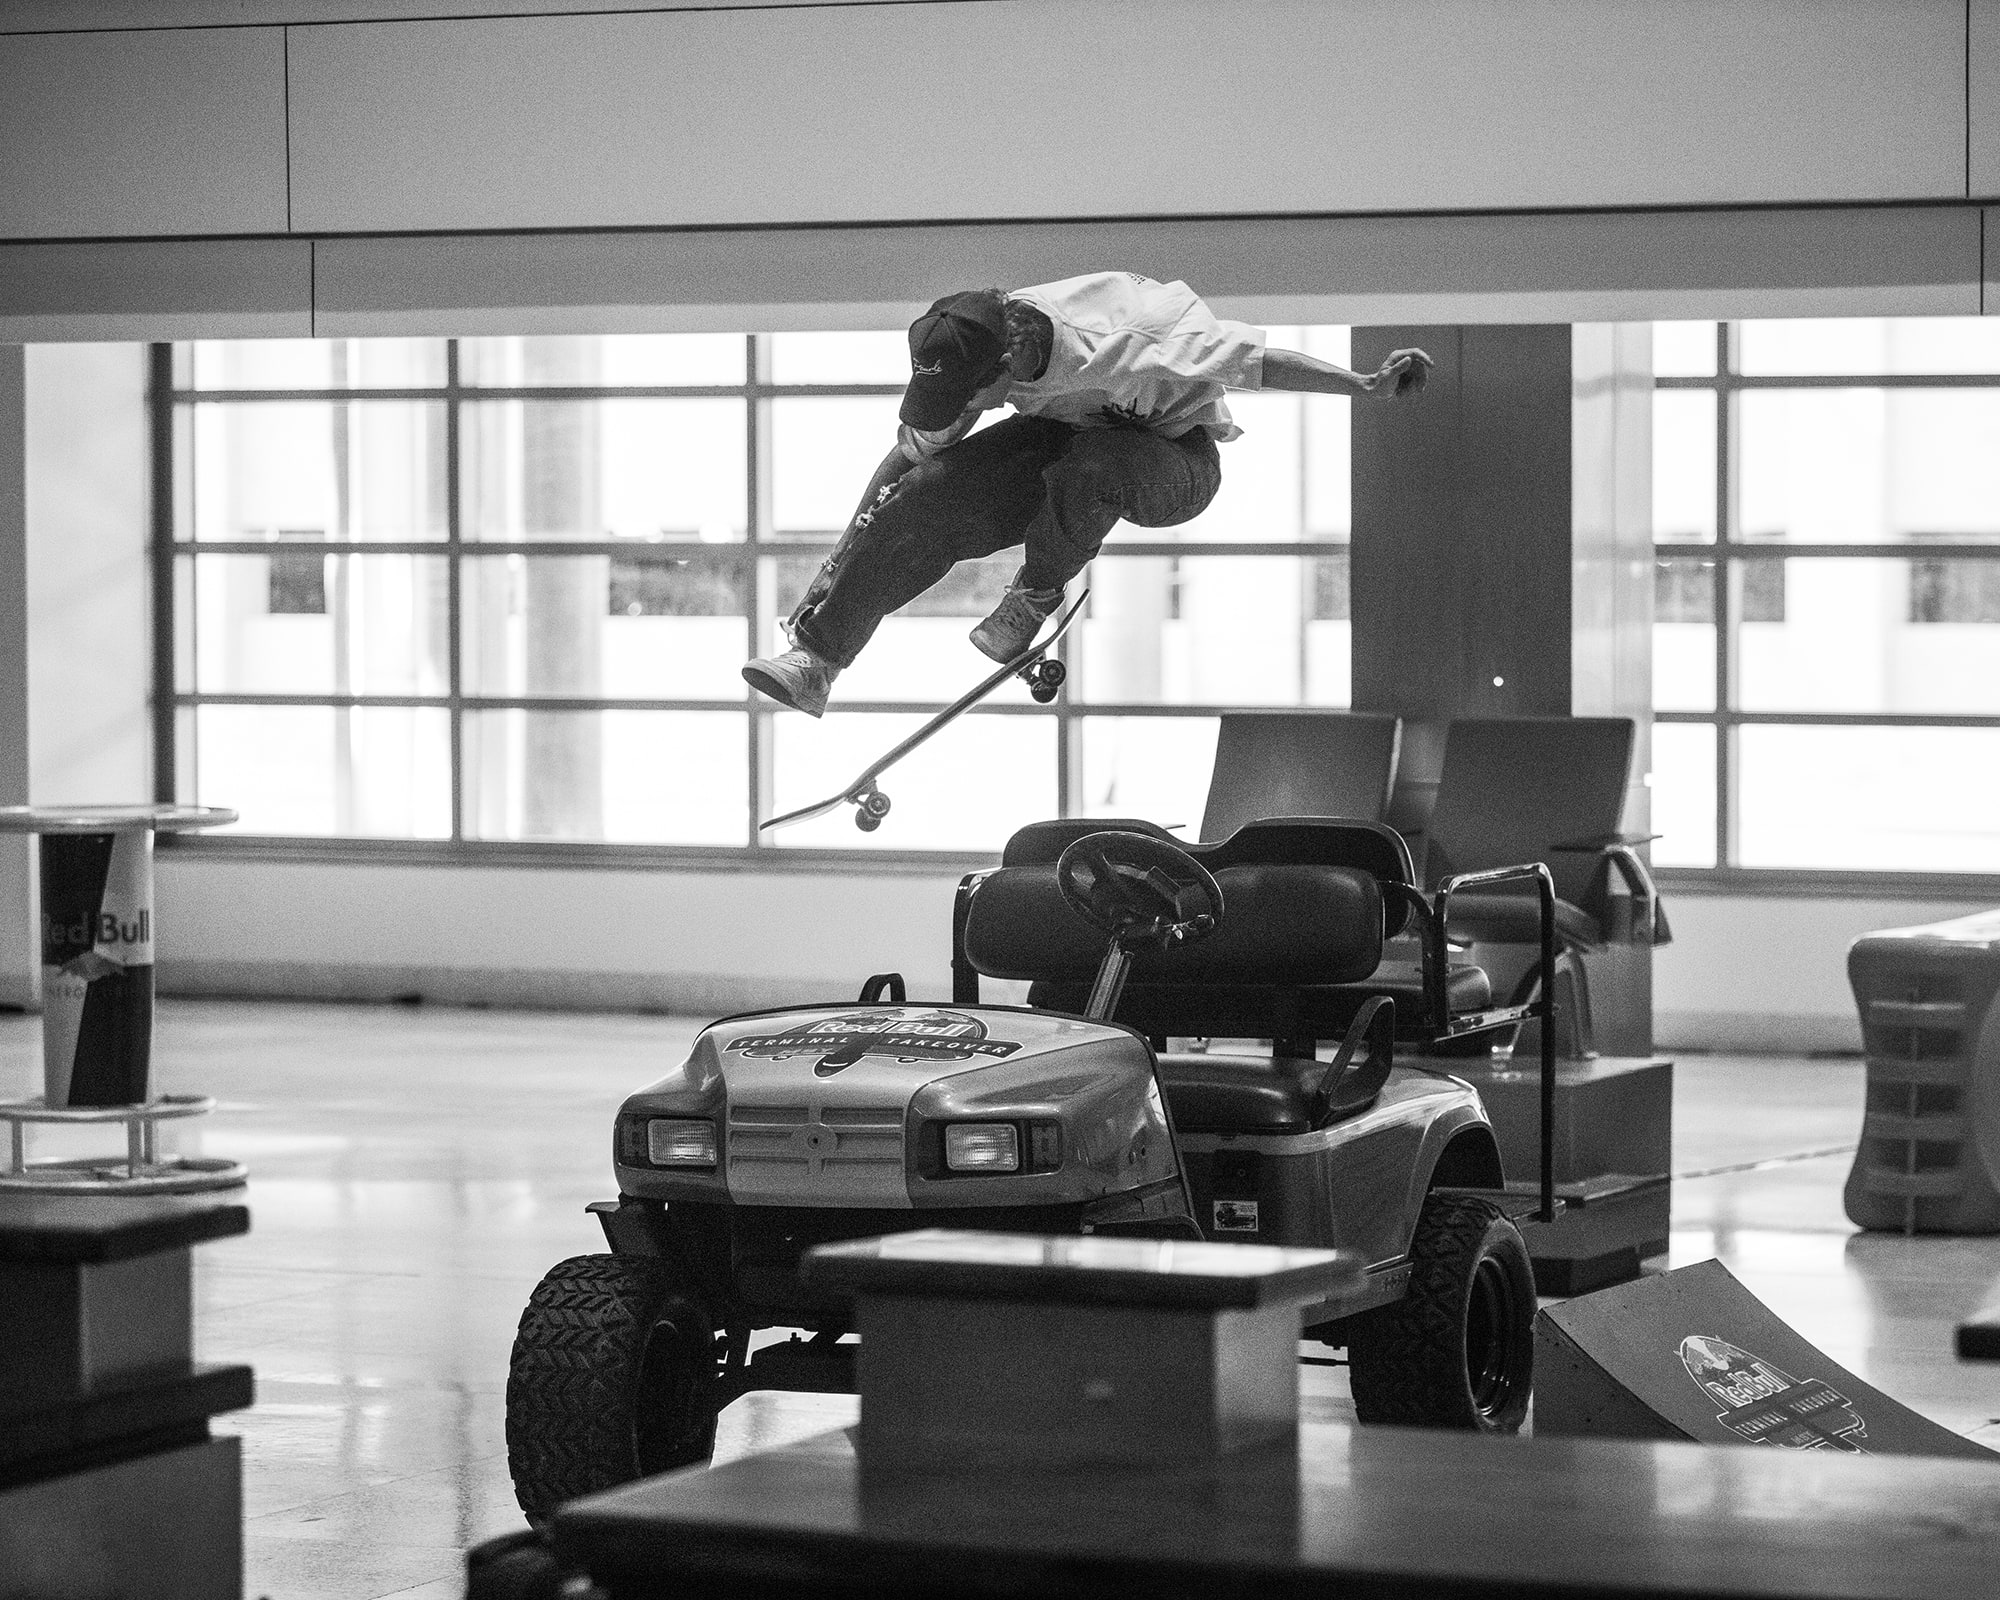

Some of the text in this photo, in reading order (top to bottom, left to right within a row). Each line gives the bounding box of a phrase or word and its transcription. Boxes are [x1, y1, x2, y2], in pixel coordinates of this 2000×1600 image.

[97, 910, 150, 944] Bull
[737, 1036, 1009, 1054] TERMINAL TAKEOVER
[807, 1021, 974, 1037] Red Bull
[1705, 1362, 1791, 1408] Red Bull
[1734, 1389, 1840, 1435] TERMINAL TAKEOVER
